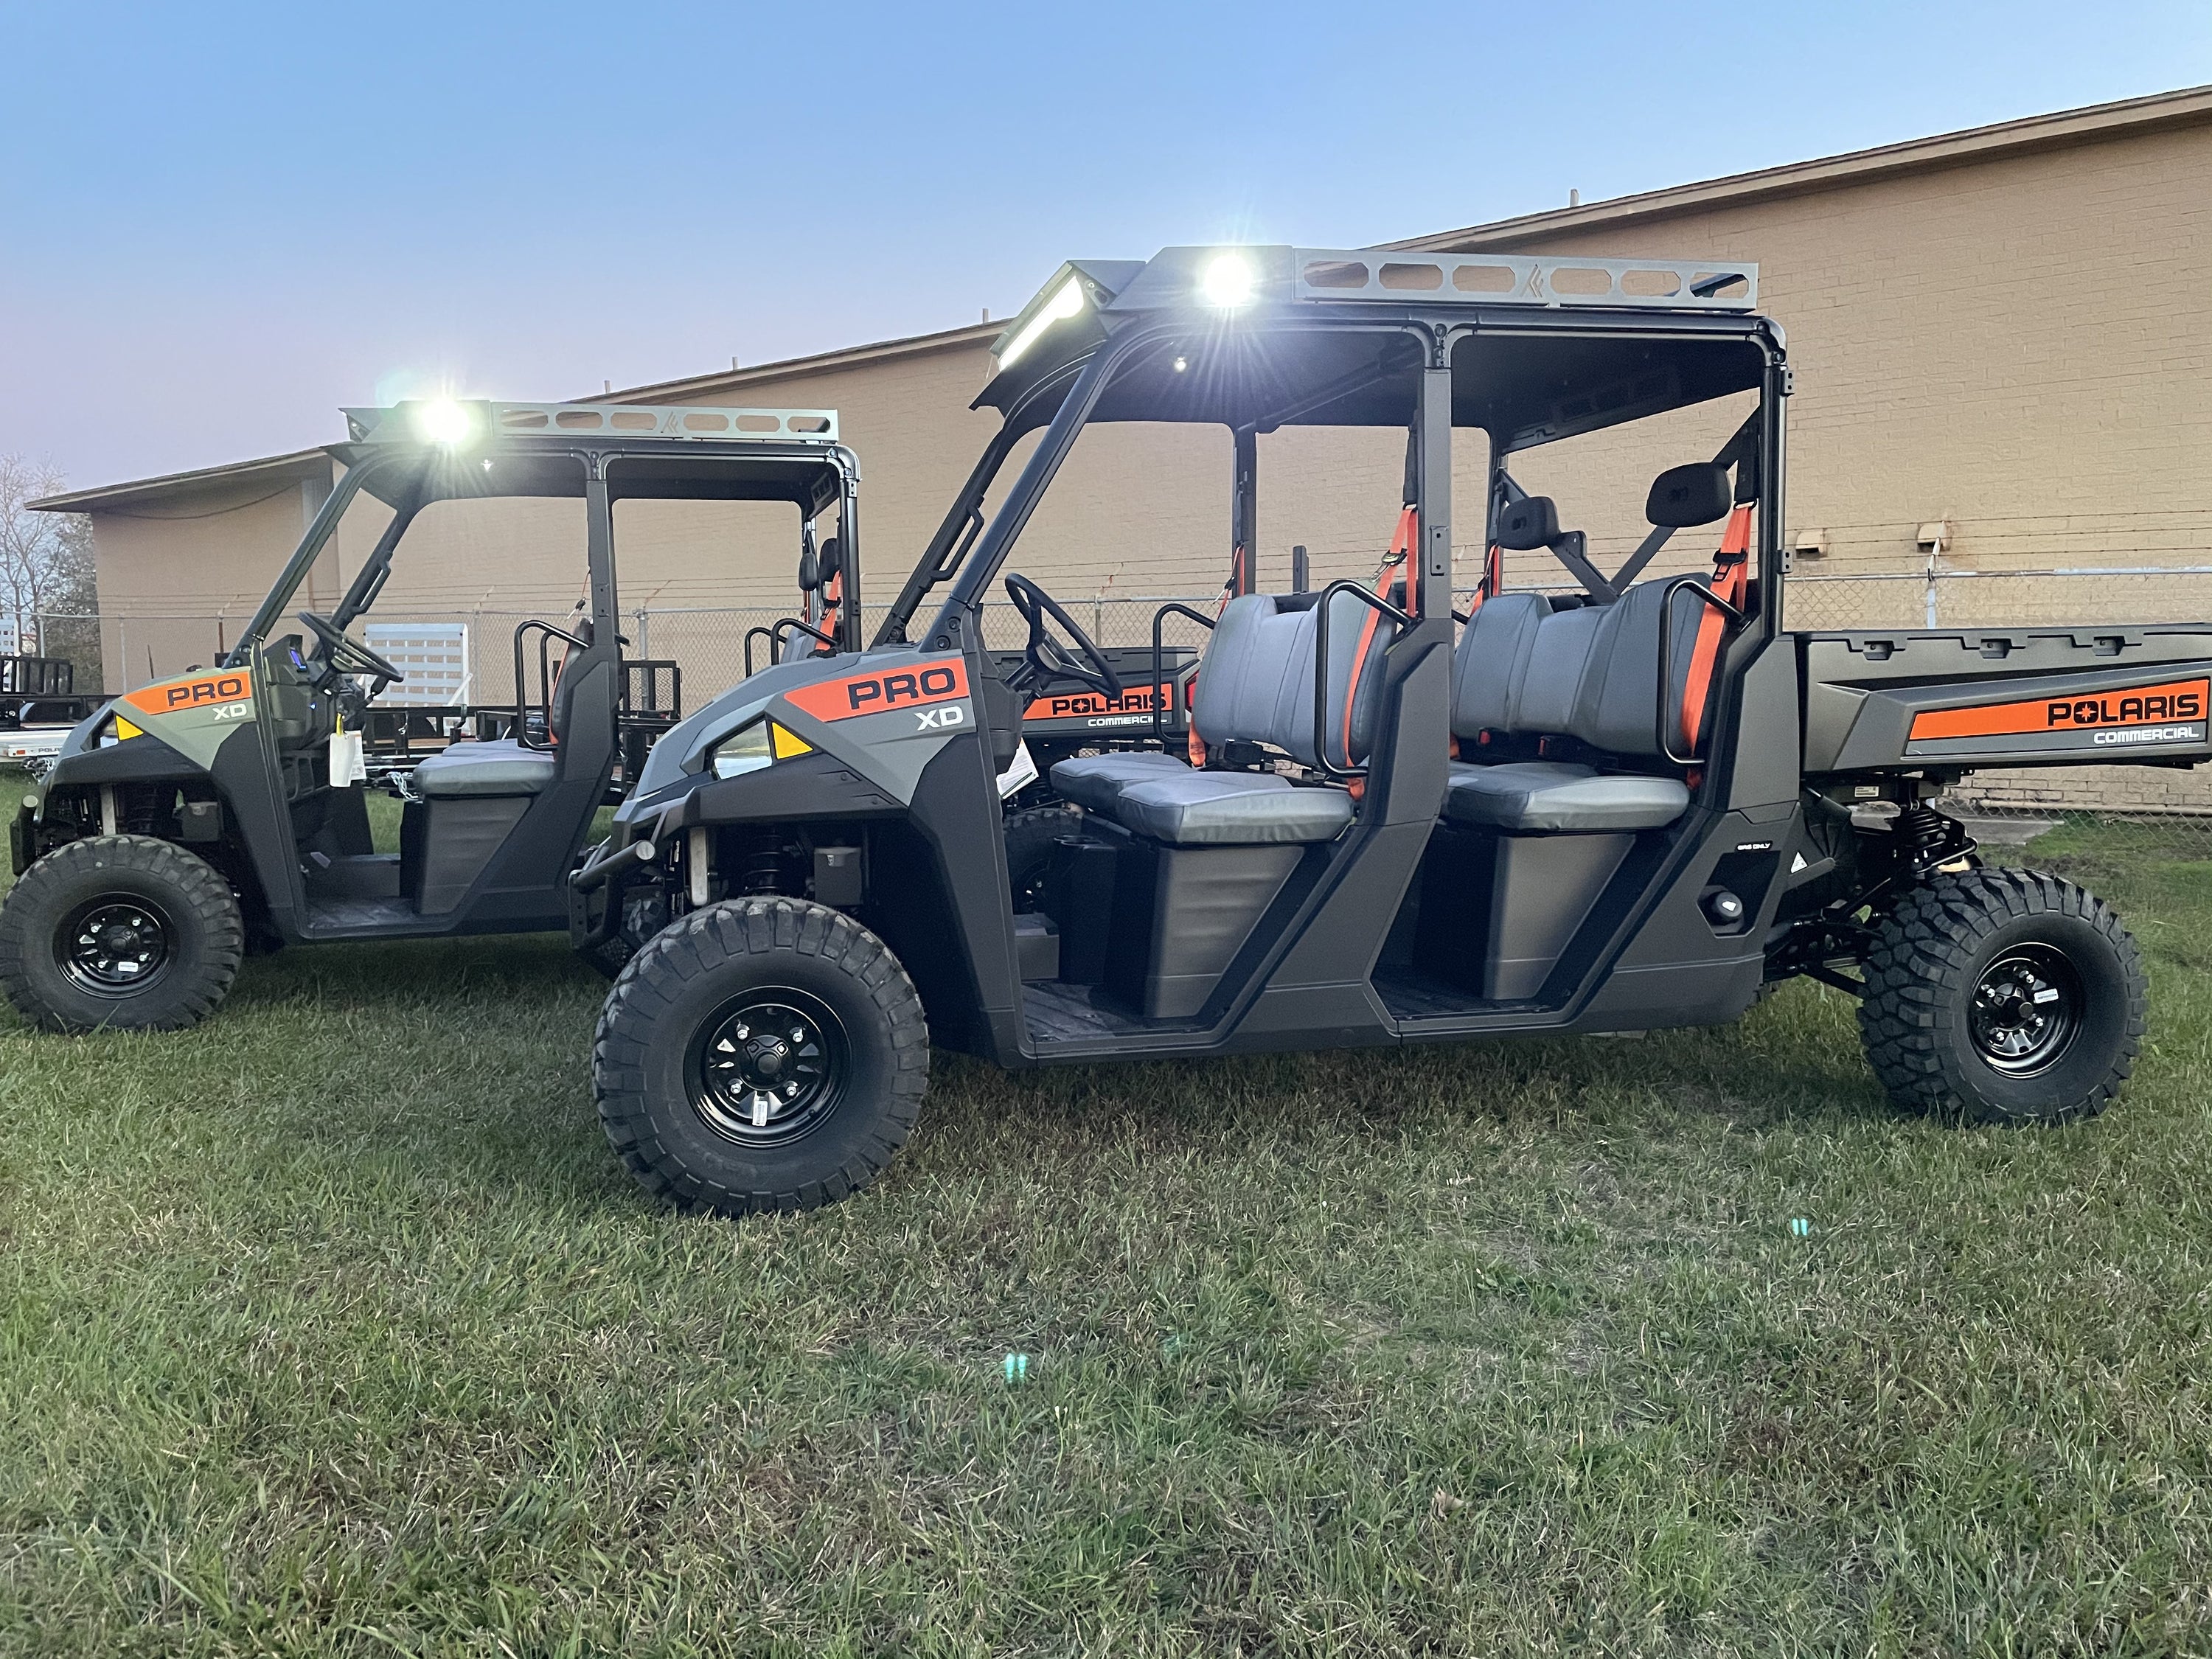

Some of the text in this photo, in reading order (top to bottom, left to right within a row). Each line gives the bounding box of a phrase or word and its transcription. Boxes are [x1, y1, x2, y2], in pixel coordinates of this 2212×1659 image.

[167, 678, 243, 706] PRO
[847, 667, 956, 710] PRO
[212, 703, 247, 720] XD
[1052, 693, 1166, 715] POLARIS
[2048, 694, 2199, 726] POLARIS
[914, 706, 964, 731] XD
[1088, 715, 1167, 727] COMMERCI
[2093, 726, 2199, 745] COMMERCIAL
